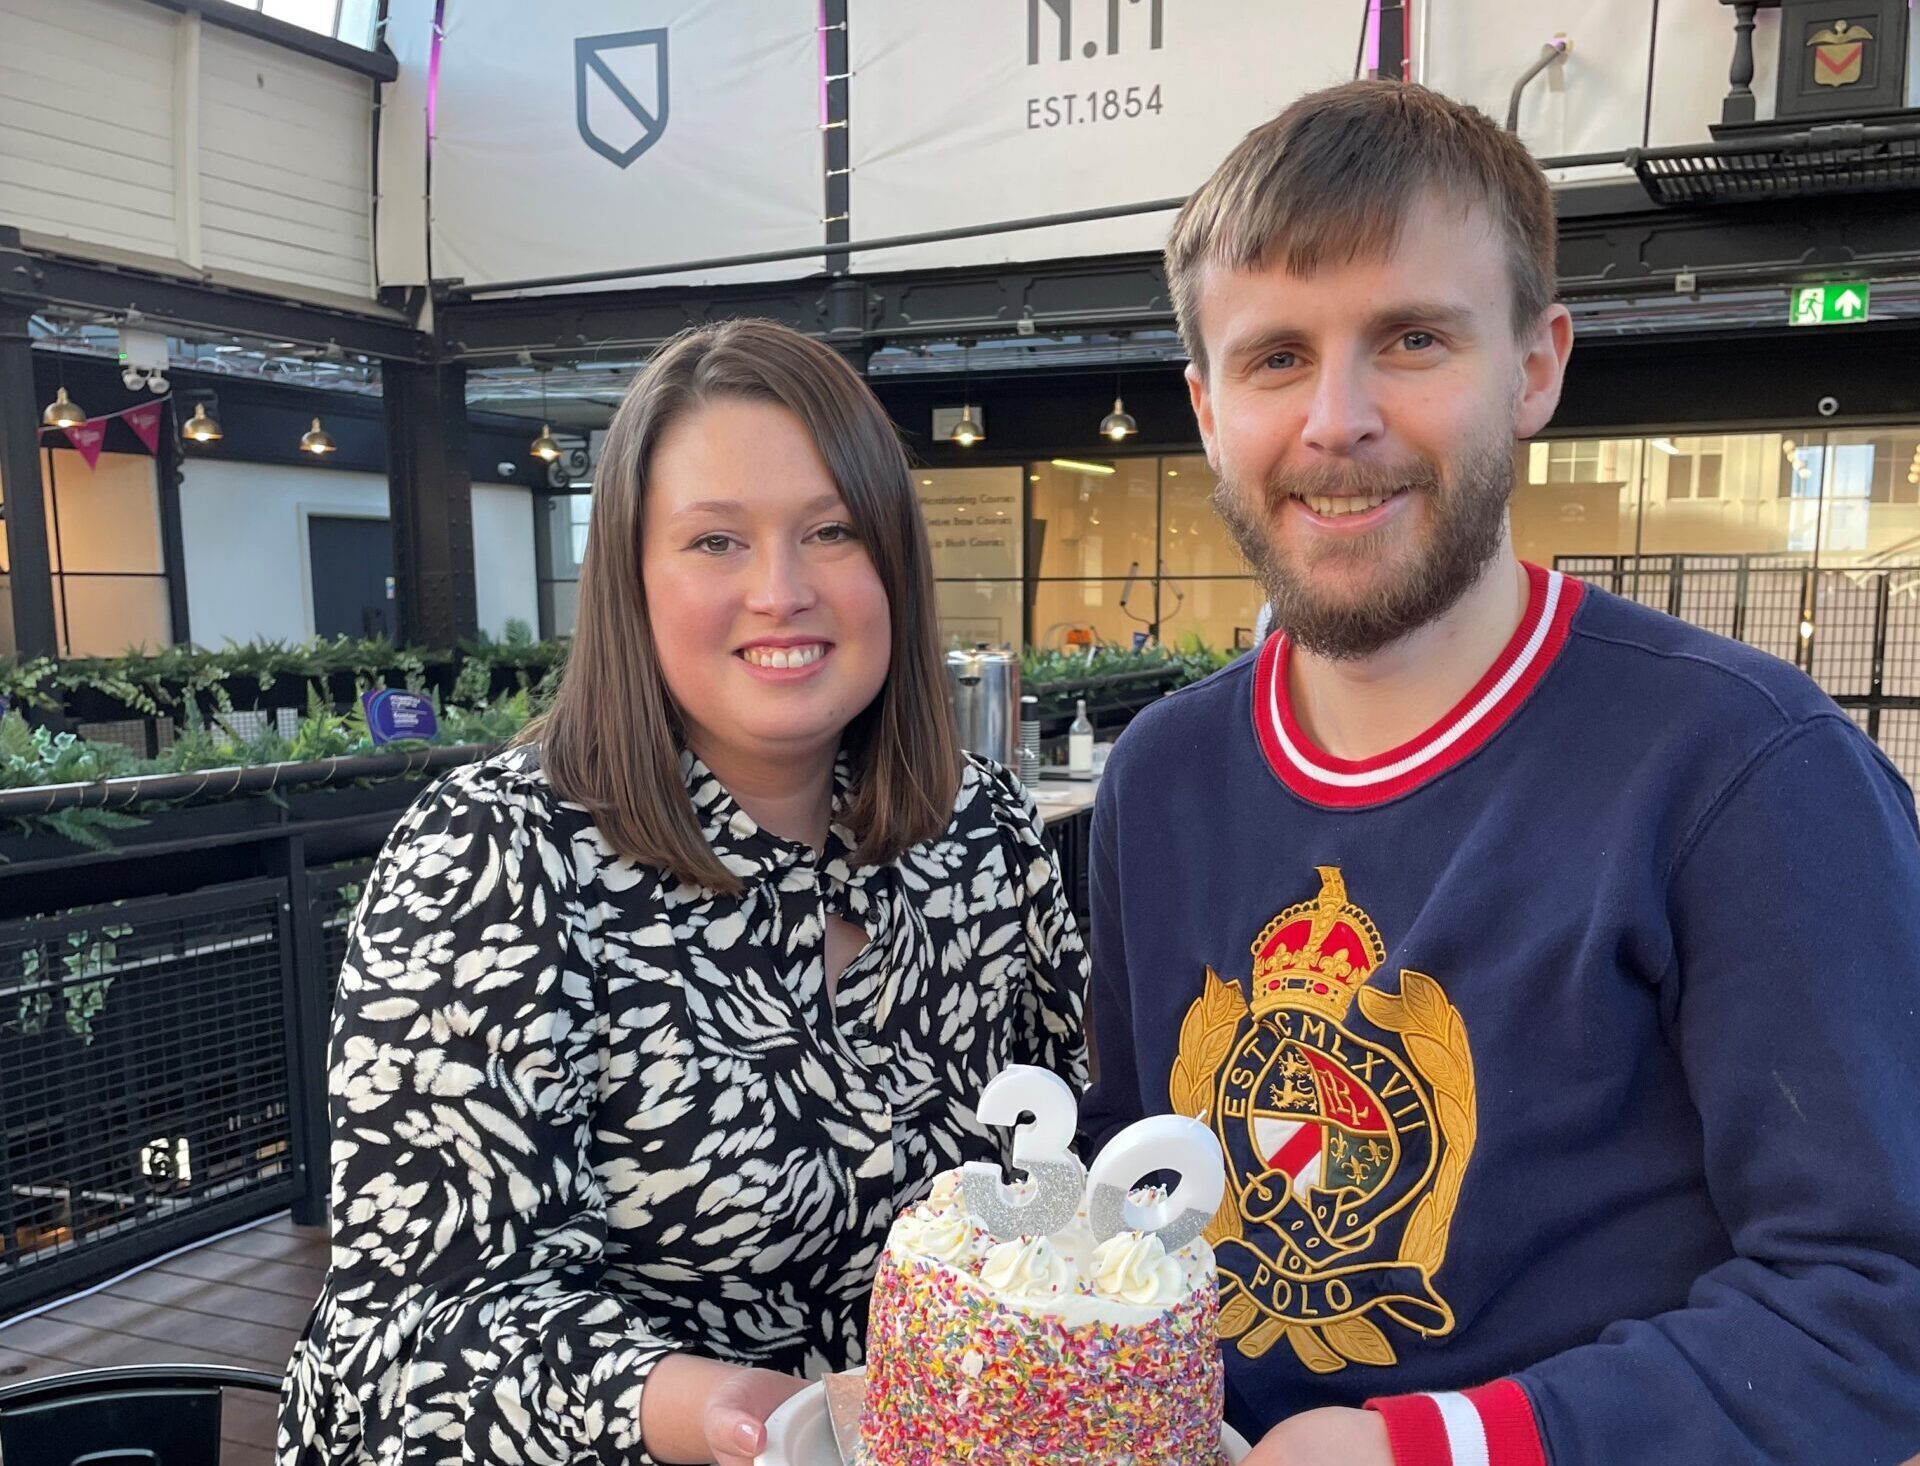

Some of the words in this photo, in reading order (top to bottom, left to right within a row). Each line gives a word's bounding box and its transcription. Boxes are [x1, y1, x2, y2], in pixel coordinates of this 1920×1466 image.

[1027, 84, 1163, 129] EST.1854
[1223, 1037, 1267, 1118] EST
[1249, 1263, 1352, 1315] POLO
